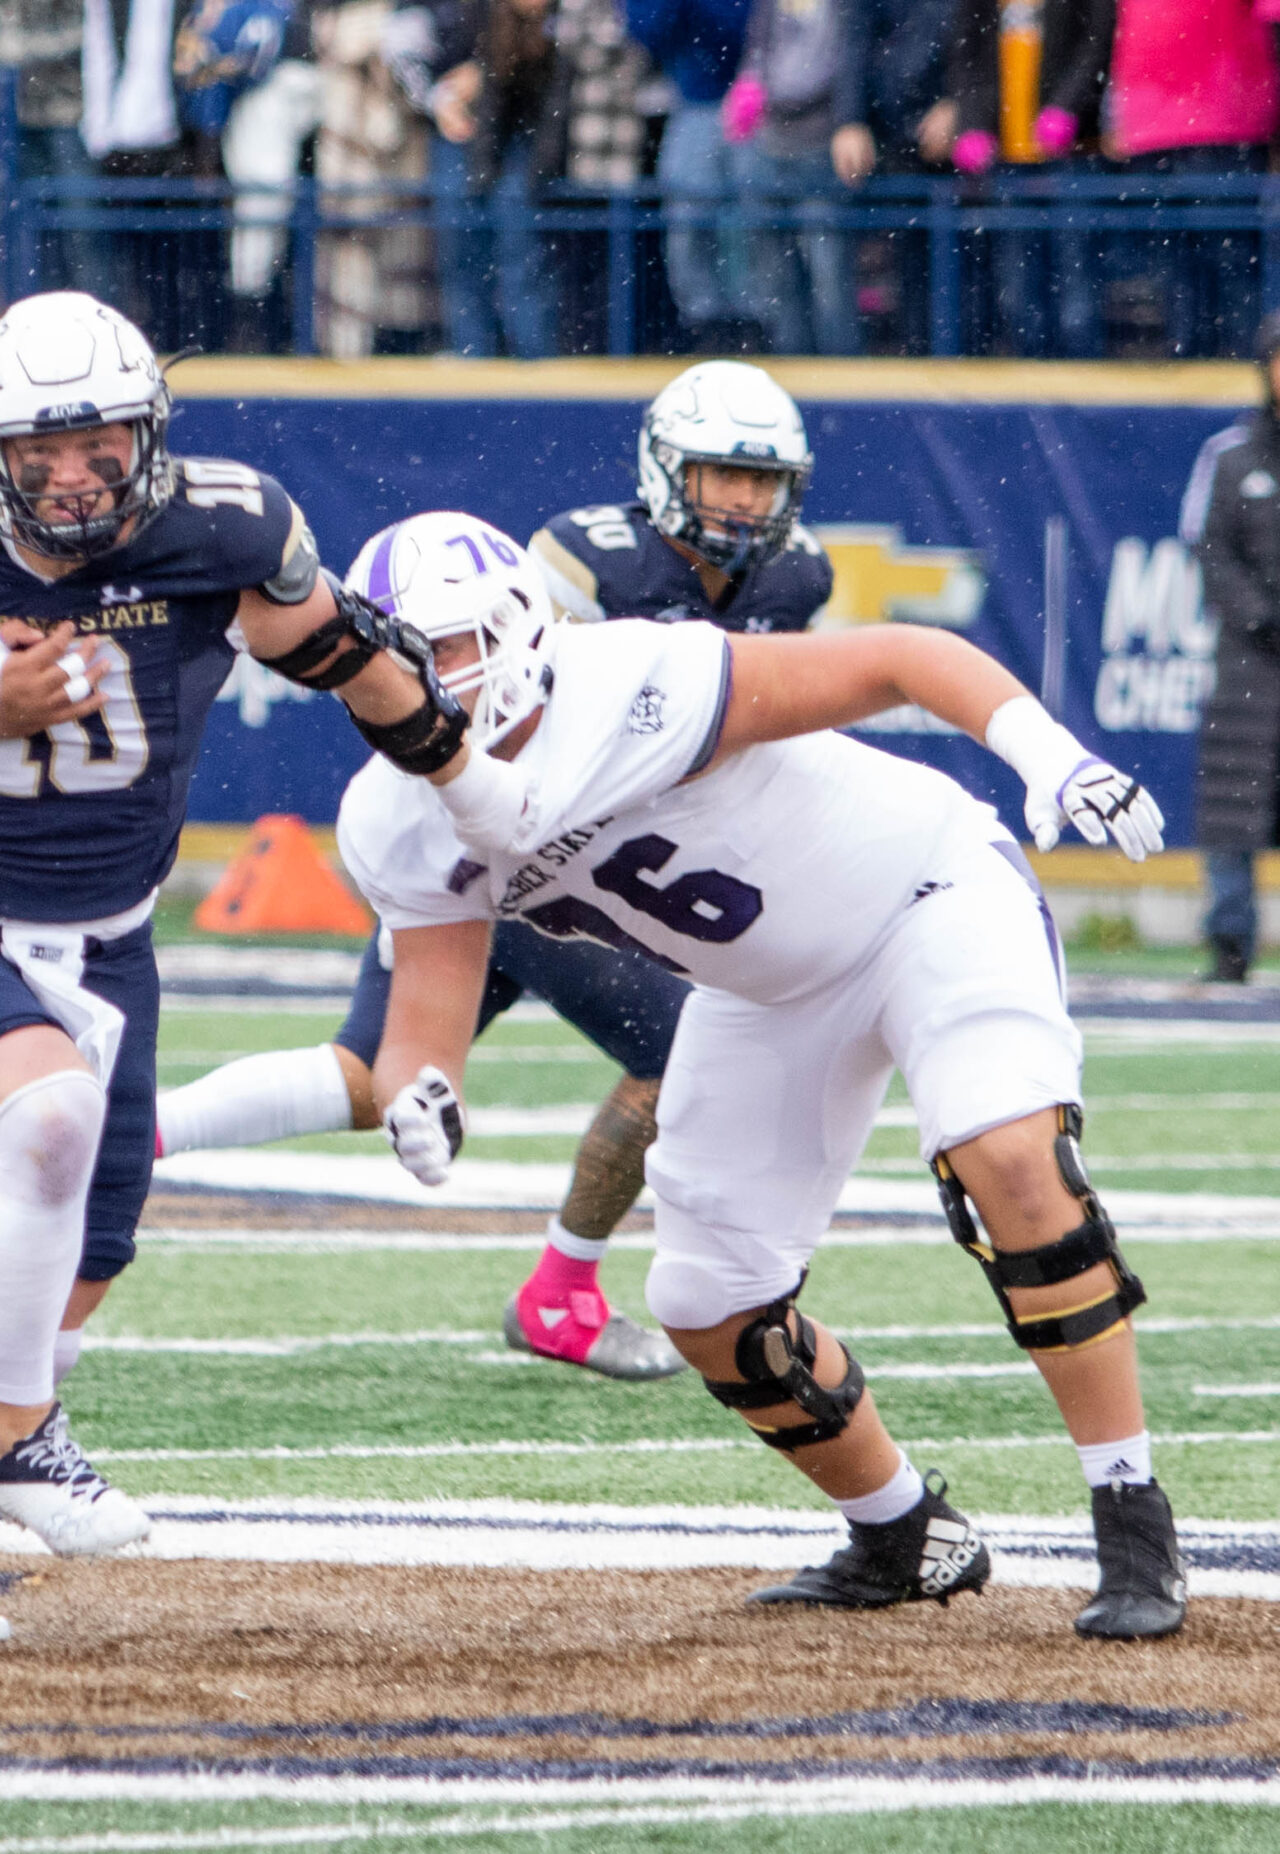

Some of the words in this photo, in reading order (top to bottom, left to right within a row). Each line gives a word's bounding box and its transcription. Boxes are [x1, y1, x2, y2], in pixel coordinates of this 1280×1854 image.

[445, 531, 519, 573] 76
[80, 600, 169, 632] STATE
[920, 1527, 981, 1595] adida
